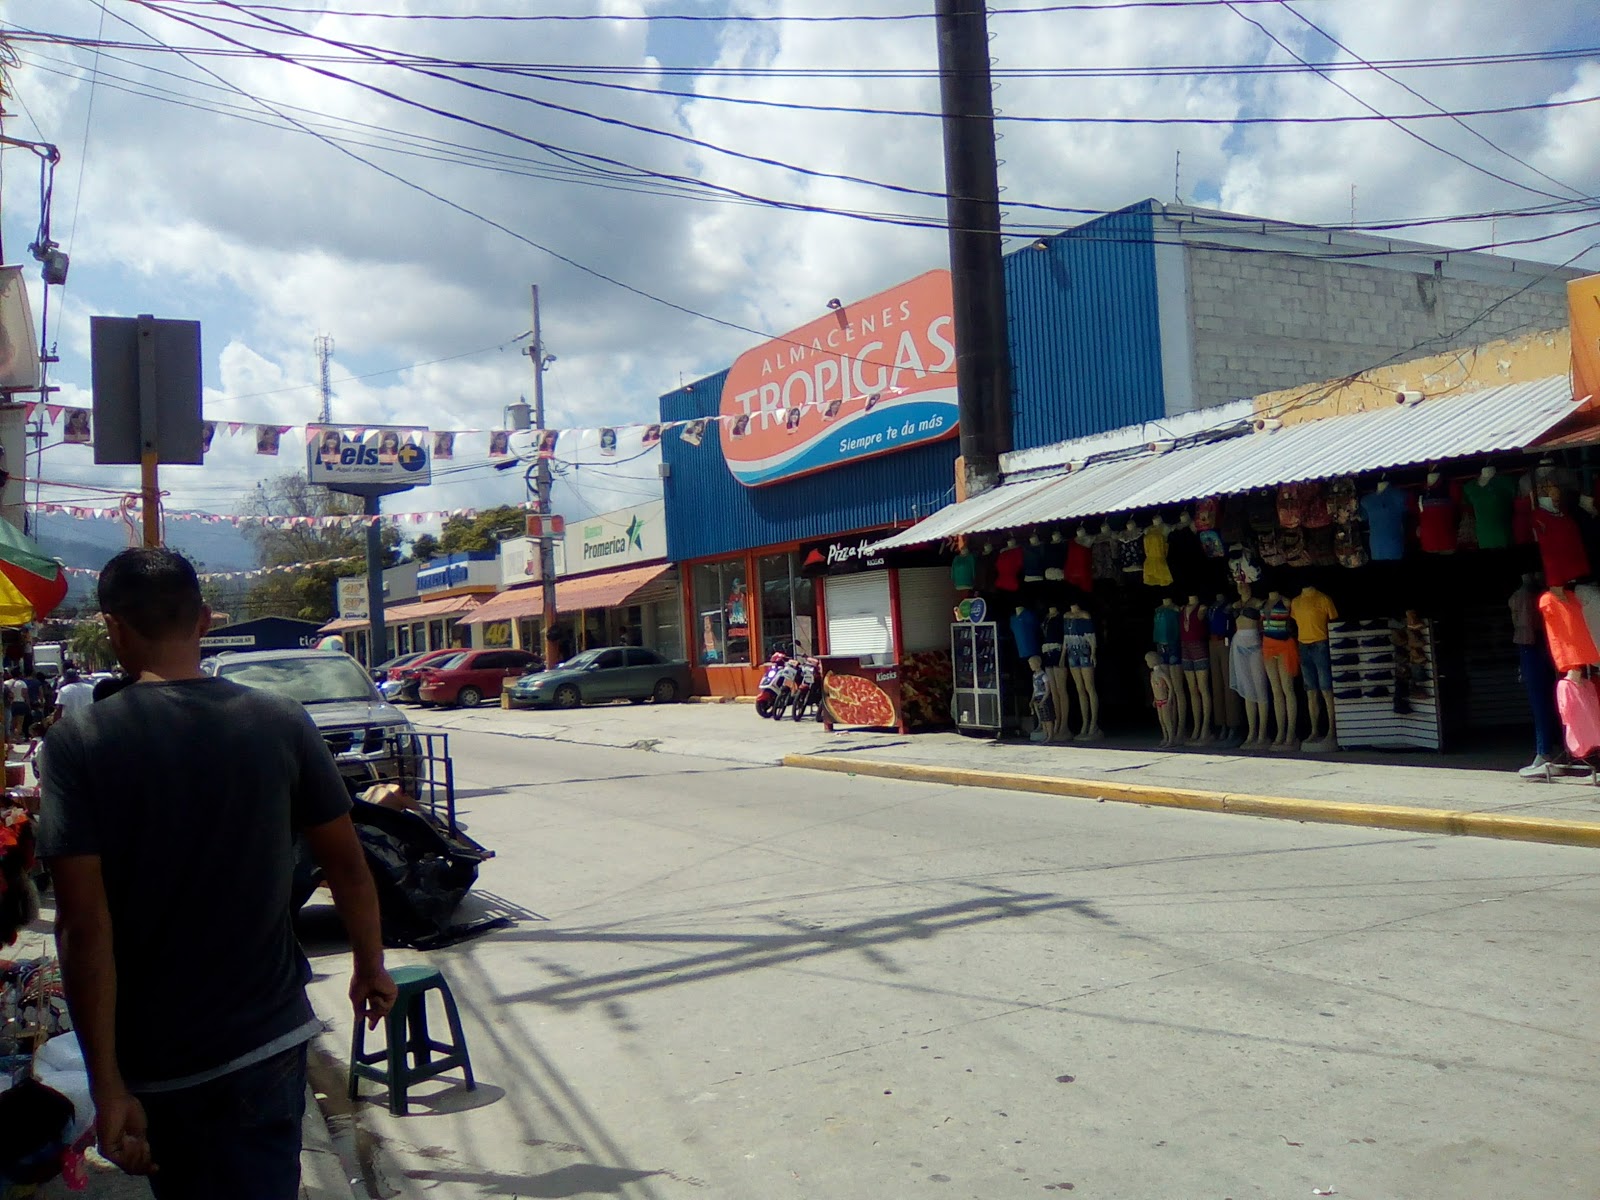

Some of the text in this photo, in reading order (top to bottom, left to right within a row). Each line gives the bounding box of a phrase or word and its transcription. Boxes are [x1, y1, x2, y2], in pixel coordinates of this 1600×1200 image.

[761, 300, 911, 376] ALMACENES
[735, 315, 956, 437] TROPIGAS
[839, 413, 943, 453] Siempre te da más
[583, 535, 626, 560] Promerica
[826, 542, 857, 566] Pizza
[485, 622, 509, 644] 40
